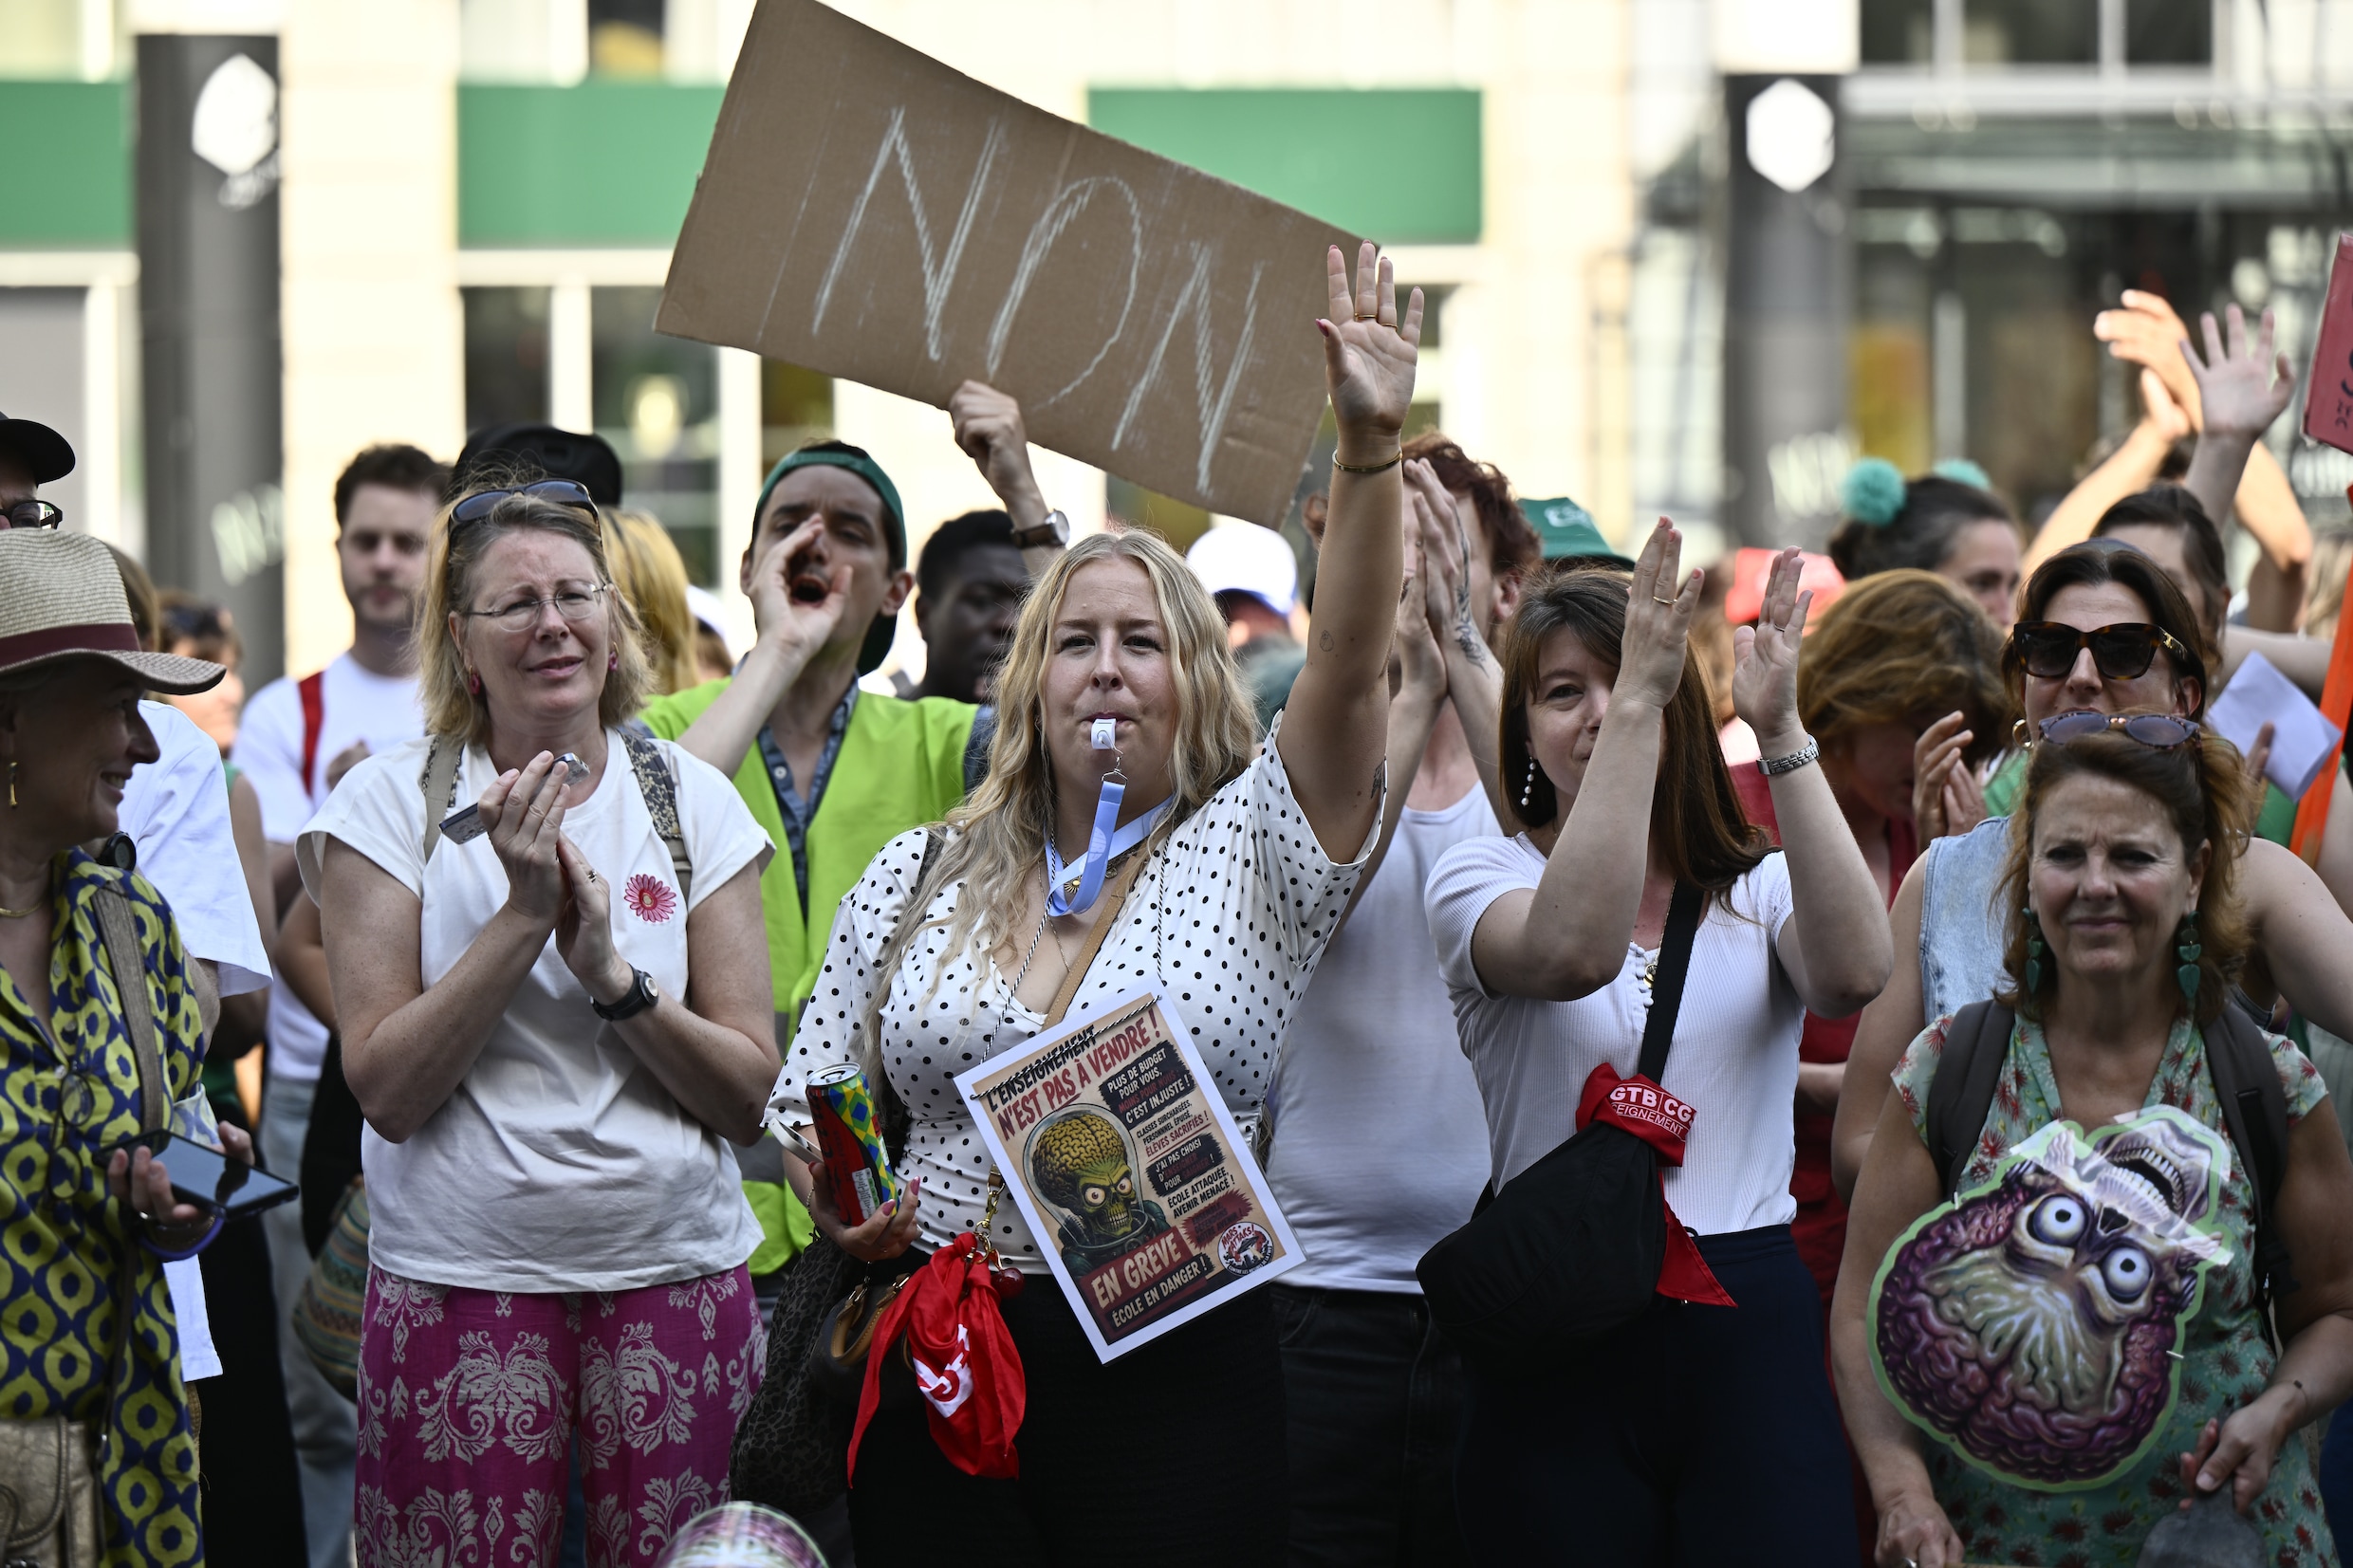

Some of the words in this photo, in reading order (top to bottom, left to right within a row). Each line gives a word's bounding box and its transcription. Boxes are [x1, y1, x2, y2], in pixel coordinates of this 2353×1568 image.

[812, 106, 1264, 497] NON
[997, 1088, 1043, 1141] N'EST
[1042, 1068, 1076, 1111] PAS
[1074, 1059, 1091, 1088] À
[1086, 1017, 1151, 1078] VENDRE
[1149, 1008, 1159, 1038] !
[1107, 1074, 1127, 1093] PLUS
[1127, 1065, 1138, 1080] DE
[1139, 1048, 1167, 1070] BUDGET
[1118, 1094, 1139, 1113] MOINS
[1139, 1082, 1158, 1100] POUR
[1158, 1070, 1176, 1088] NOUS
[1119, 1080, 1139, 1099] POUR
[1125, 1100, 1148, 1123] C'EST
[1150, 1080, 1185, 1109] INJUSTE
[1183, 1074, 1191, 1086] !
[1664, 1098, 1695, 1125] CG
[1136, 1120, 1157, 1138] CLASSES
[1142, 1123, 1174, 1145] PERSONNEL
[1145, 1135, 1170, 1157] ÉLÈVES
[1170, 1114, 1204, 1141] SACRIFIÉS
[1203, 1110, 1209, 1120] !
[1156, 1160, 1168, 1172] J'AI
[1168, 1151, 1180, 1167] PAS
[1180, 1137, 1202, 1156] CHOISI
[1164, 1174, 1181, 1190] POUR
[1167, 1188, 1190, 1208] ÉCOLE
[1173, 1197, 1199, 1219] AVENIR
[1199, 1178, 1231, 1204] MENACÉ
[1230, 1174, 1235, 1185] !
[1221, 1227, 1238, 1248] MARS
[1091, 1266, 1122, 1309] EN
[1123, 1232, 1182, 1289] GRÈVE
[1112, 1298, 1144, 1327] ÉCOLE
[1144, 1287, 1159, 1306] EN
[1159, 1261, 1200, 1297] DANGER
[1199, 1255, 1207, 1271] !
